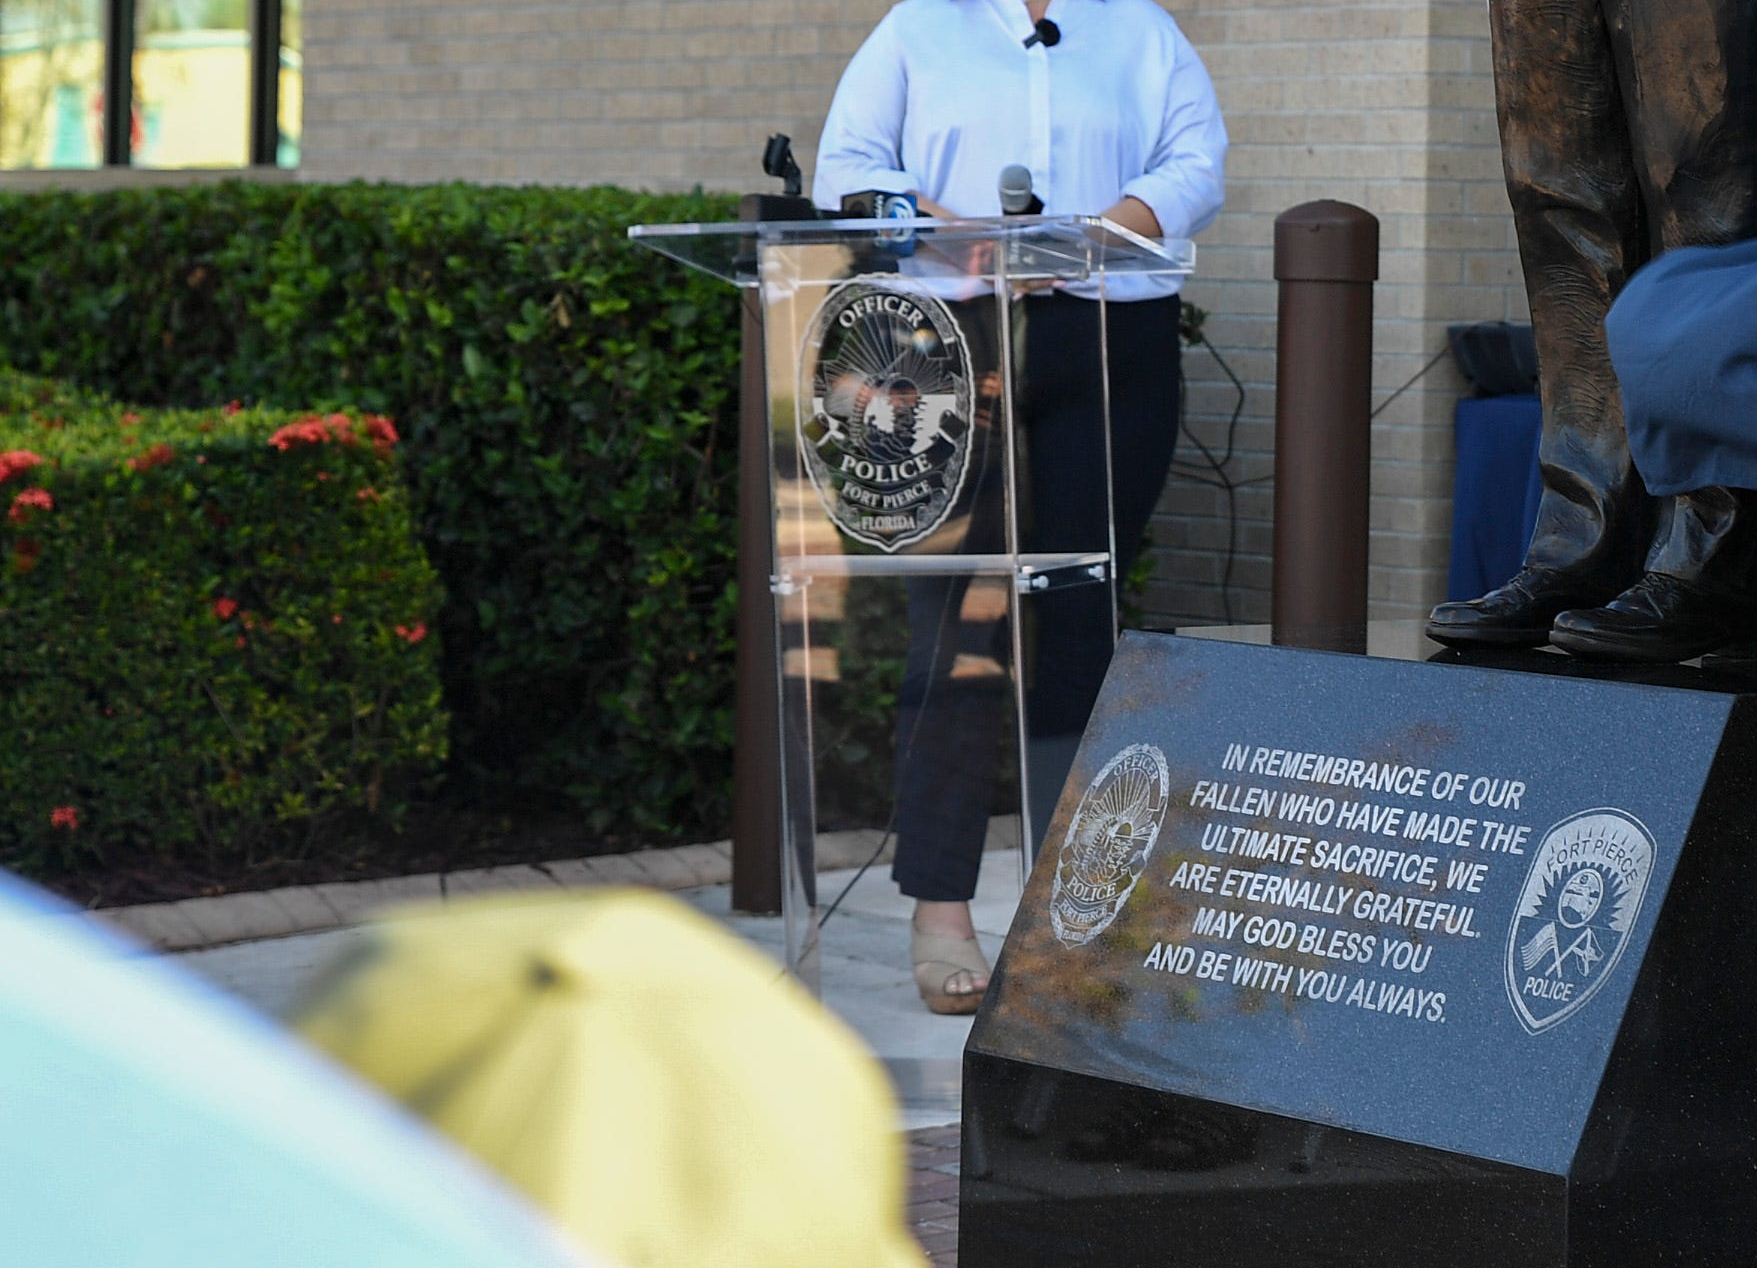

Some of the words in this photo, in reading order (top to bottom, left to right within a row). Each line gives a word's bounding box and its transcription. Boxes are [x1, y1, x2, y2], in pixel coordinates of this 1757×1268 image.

[839, 295, 924, 328] OFFICER
[840, 453, 932, 482] POLICE
[842, 482, 880, 507] FORT
[883, 479, 930, 508] PIERCE
[861, 516, 916, 530] FLORIDA
[1113, 754, 1159, 784] OFFICER
[1222, 743, 1250, 771] IN
[1249, 747, 1431, 797] REMEMBRANCE
[1431, 772, 1469, 801] OF
[1469, 777, 1526, 811] OUR
[1189, 780, 1278, 818] FALLEN
[1278, 791, 1335, 826] WHO
[1335, 800, 1404, 837] HAVE
[1402, 810, 1478, 847] MADE
[1480, 821, 1531, 855] THE
[1201, 823, 1312, 866] ULTIMATE
[1310, 840, 1438, 892] SACRIFICE,
[1446, 859, 1489, 894] WE
[1546, 839, 1590, 873] FORT
[1593, 838, 1639, 885] PIERCE
[1066, 875, 1117, 901] POLICE
[1169, 861, 1221, 894] ARE
[1219, 869, 1354, 916] ETERNALLY
[1353, 890, 1481, 938] GRATEFUL.
[1192, 907, 1244, 940] MAY
[1243, 916, 1297, 950] GOD
[1297, 924, 1377, 964] BLESS
[1380, 938, 1433, 974] YOU
[1143, 942, 1196, 975] AND
[1195, 950, 1233, 982] BE
[1231, 956, 1294, 994] WITH
[1296, 967, 1348, 1004] YOU
[1345, 978, 1447, 1023] ALWAYS.
[1522, 976, 1574, 1002] POLICE
